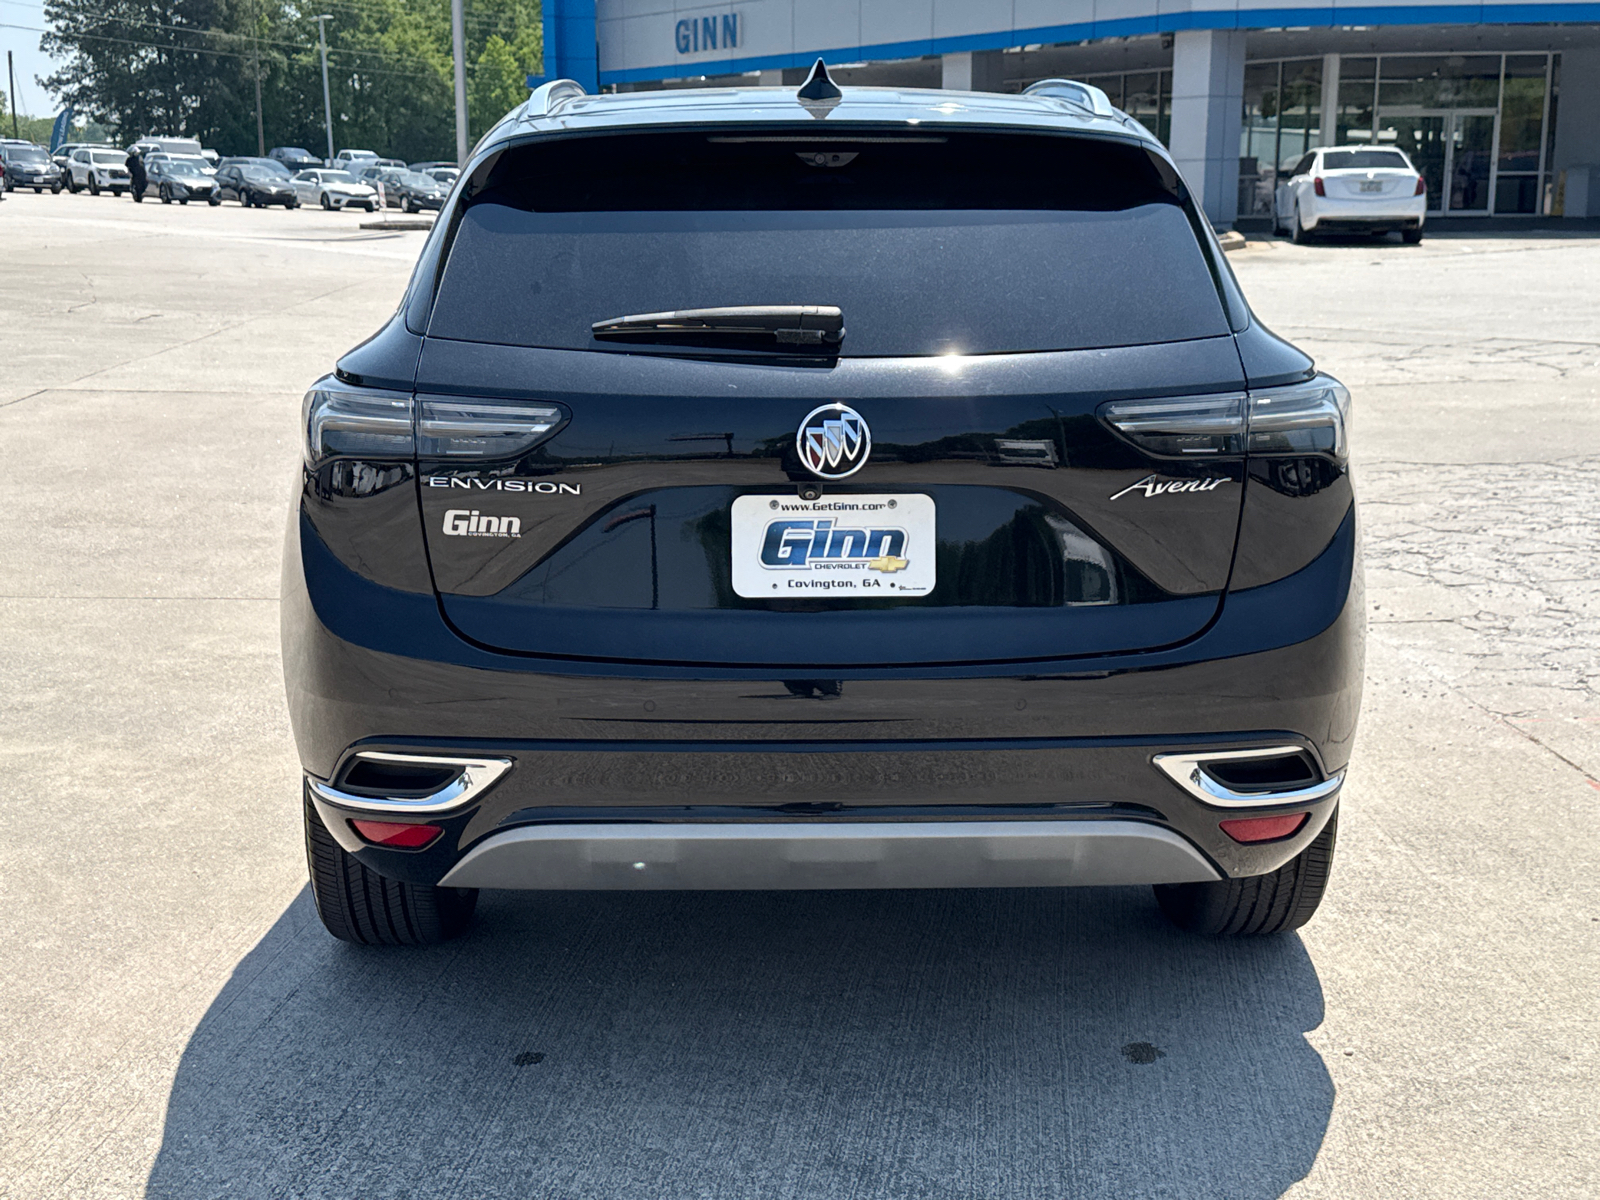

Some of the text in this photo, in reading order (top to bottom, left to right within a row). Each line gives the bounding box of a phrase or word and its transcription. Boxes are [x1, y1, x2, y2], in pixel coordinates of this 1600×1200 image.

[675, 13, 738, 54] GINN
[429, 476, 581, 495] ENVISION
[1109, 474, 1232, 500] Avenir
[442, 509, 521, 536] Ginn
[760, 519, 907, 566] Ginn
[787, 579, 881, 589] Covington, GA
